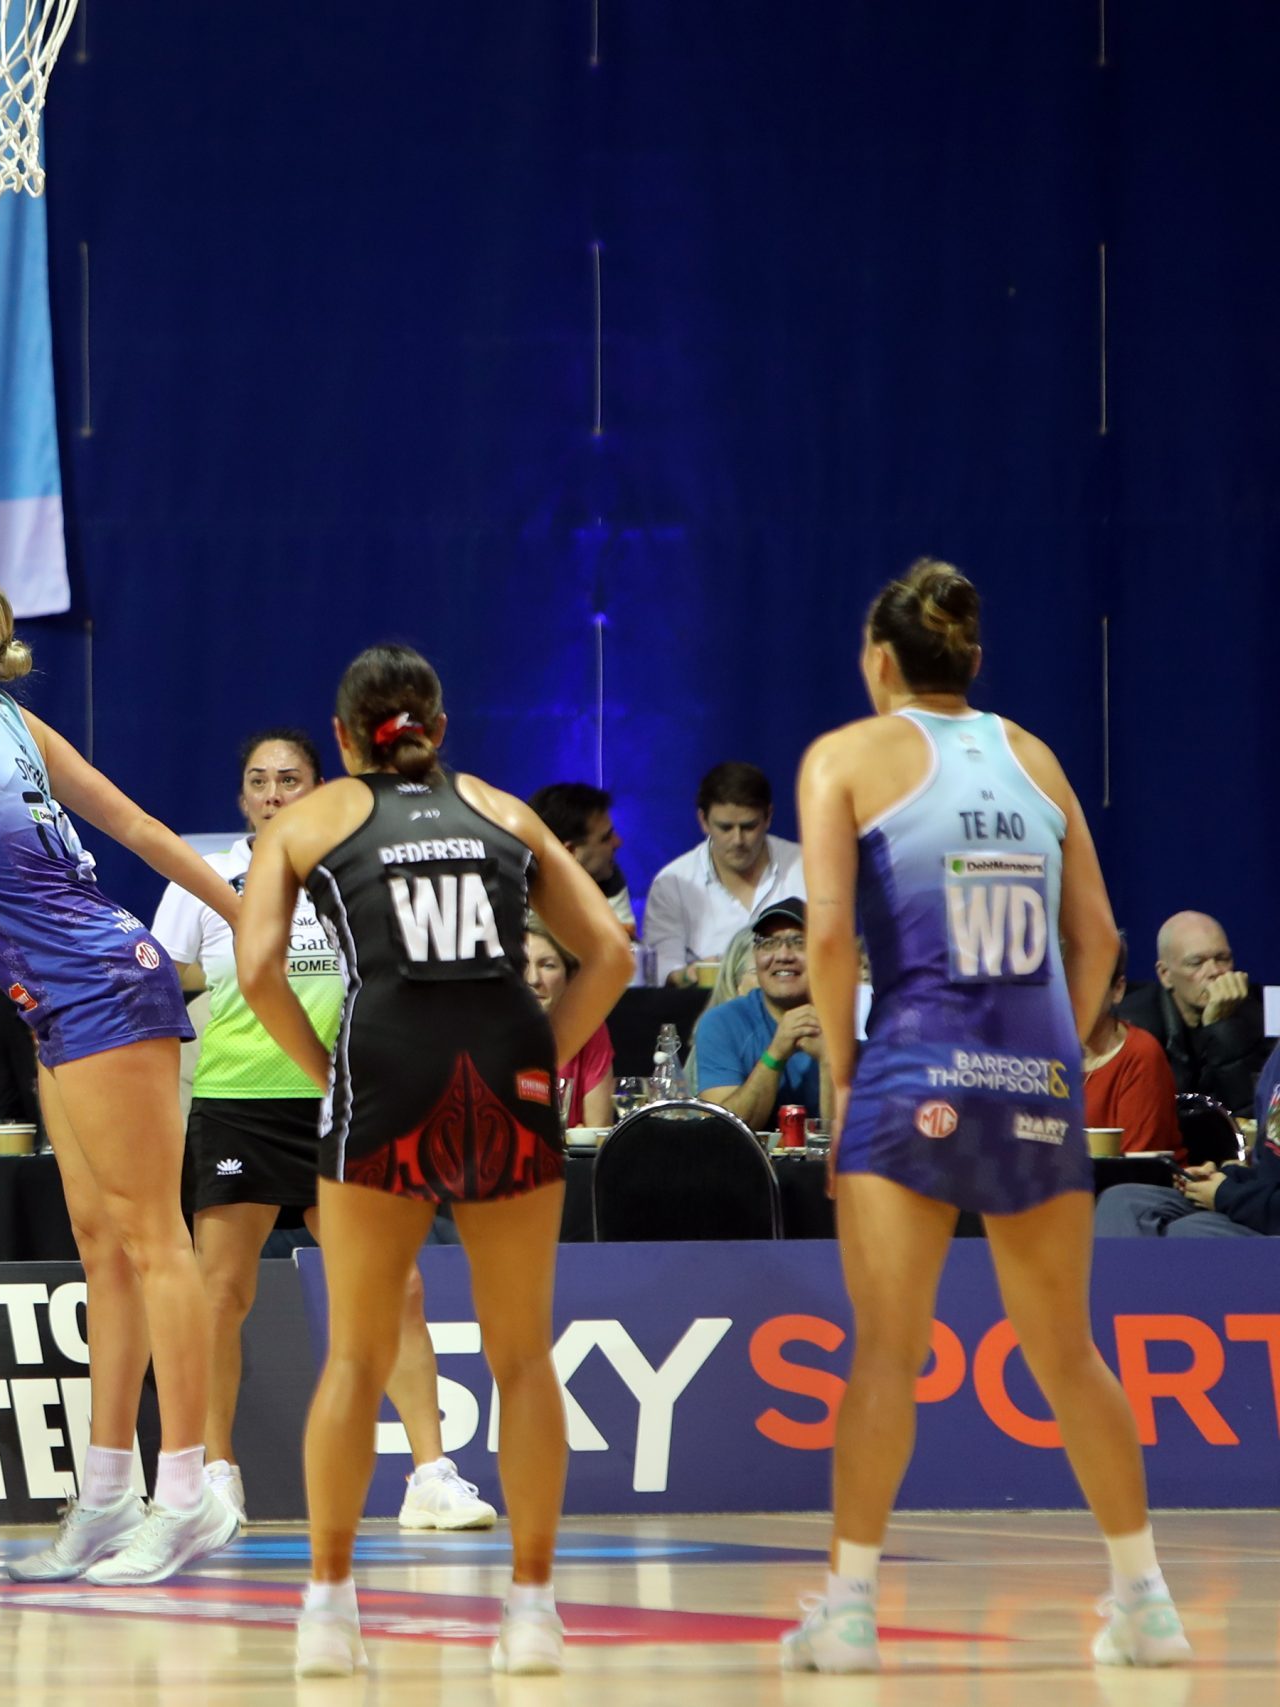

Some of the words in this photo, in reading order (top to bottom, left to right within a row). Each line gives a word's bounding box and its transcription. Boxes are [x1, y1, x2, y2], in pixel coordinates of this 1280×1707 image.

[959, 811, 988, 840] TE
[996, 811, 1026, 841] AO
[379, 838, 486, 865] PEDERSEN
[967, 860, 1044, 874] DebtManagers
[389, 872, 505, 961] WA
[948, 884, 1047, 977] WD
[136, 942, 160, 969] MG
[928, 1065, 1050, 1096] THOMPSON
[953, 1049, 1051, 1078] BARFOOT
[1049, 1059, 1070, 1099] &
[917, 1101, 958, 1138] MG
[1014, 1111, 1069, 1137] HART
